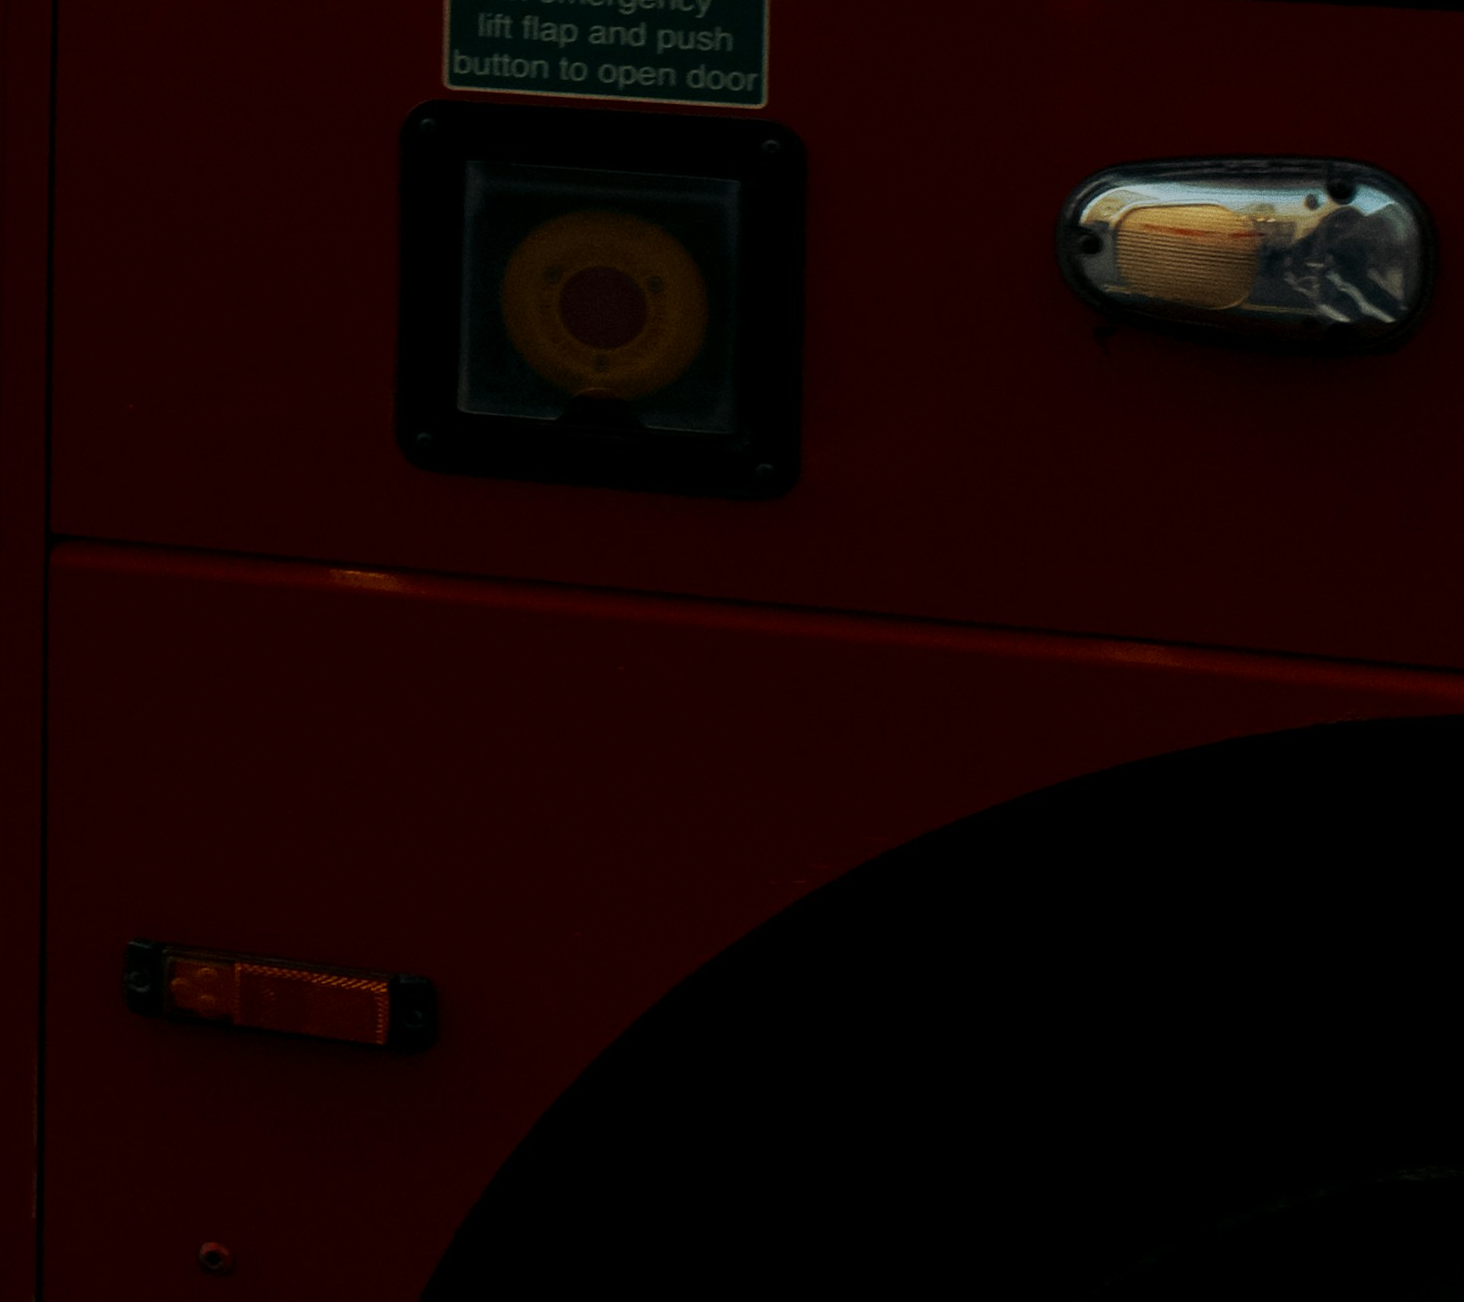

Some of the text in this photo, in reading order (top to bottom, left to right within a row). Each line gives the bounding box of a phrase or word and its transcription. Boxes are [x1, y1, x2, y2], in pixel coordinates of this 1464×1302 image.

[477, 12, 734, 55] lift flap and push
[452, 49, 760, 93] button to open door
